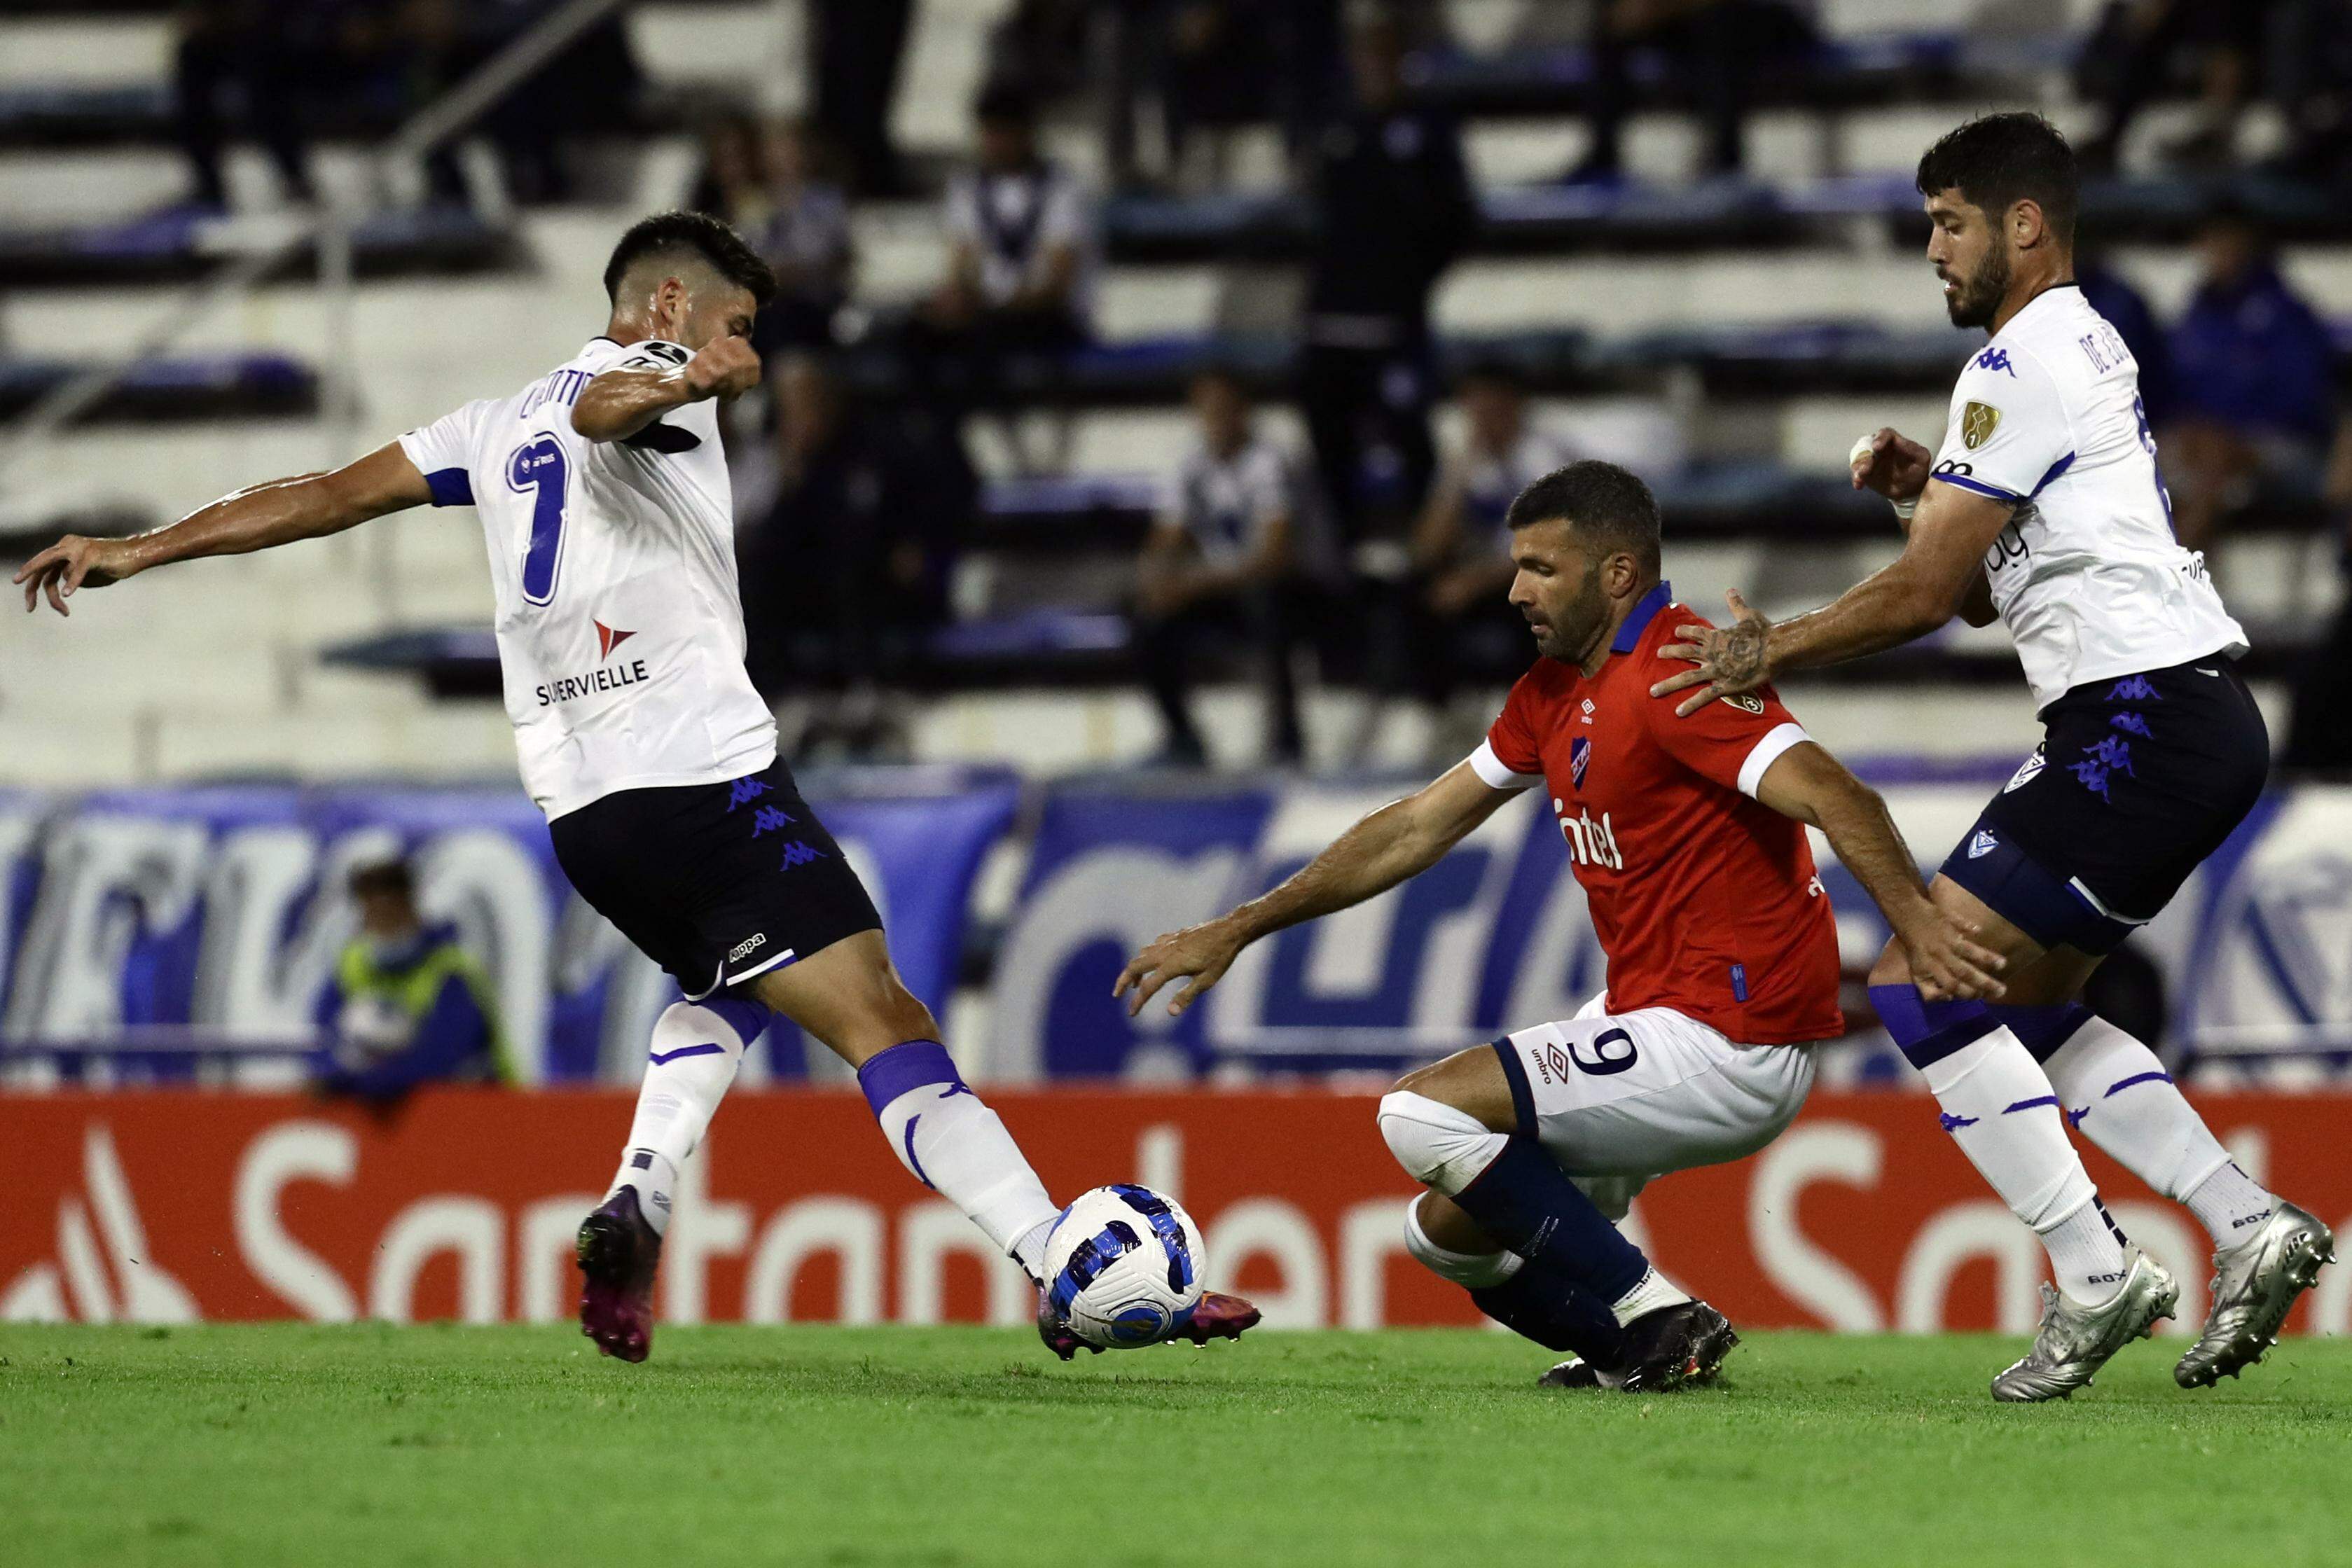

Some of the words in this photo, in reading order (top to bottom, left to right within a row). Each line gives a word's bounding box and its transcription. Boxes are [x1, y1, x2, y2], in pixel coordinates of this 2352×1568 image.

[1747, 700, 1759, 711] 3
[1531, 1048, 1552, 1085] umbro
[1566, 1027, 1638, 1076] 9
[233, 1123, 1418, 1327] Santaner
